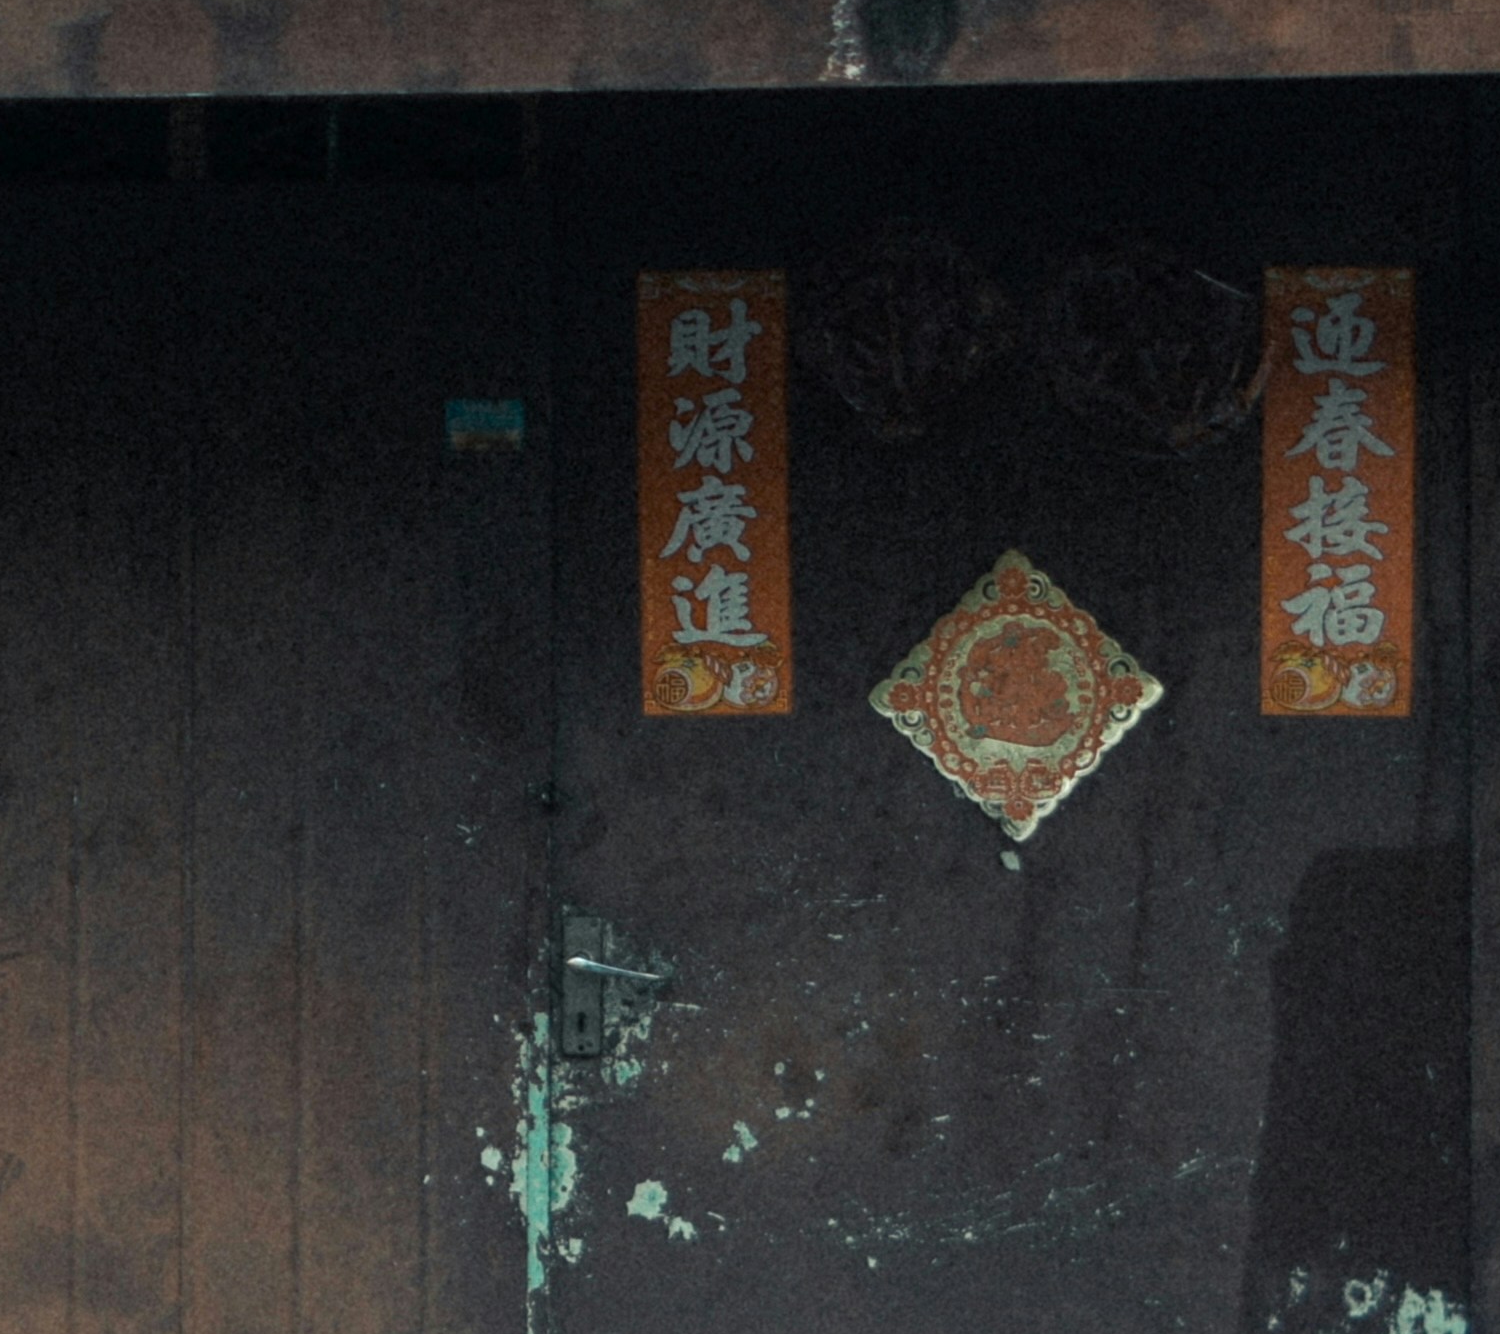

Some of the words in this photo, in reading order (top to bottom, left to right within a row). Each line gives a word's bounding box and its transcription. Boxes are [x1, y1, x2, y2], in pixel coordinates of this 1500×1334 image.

[658, 297, 769, 646] 財源廣進
[1280, 293, 1396, 646] 迎春接福
